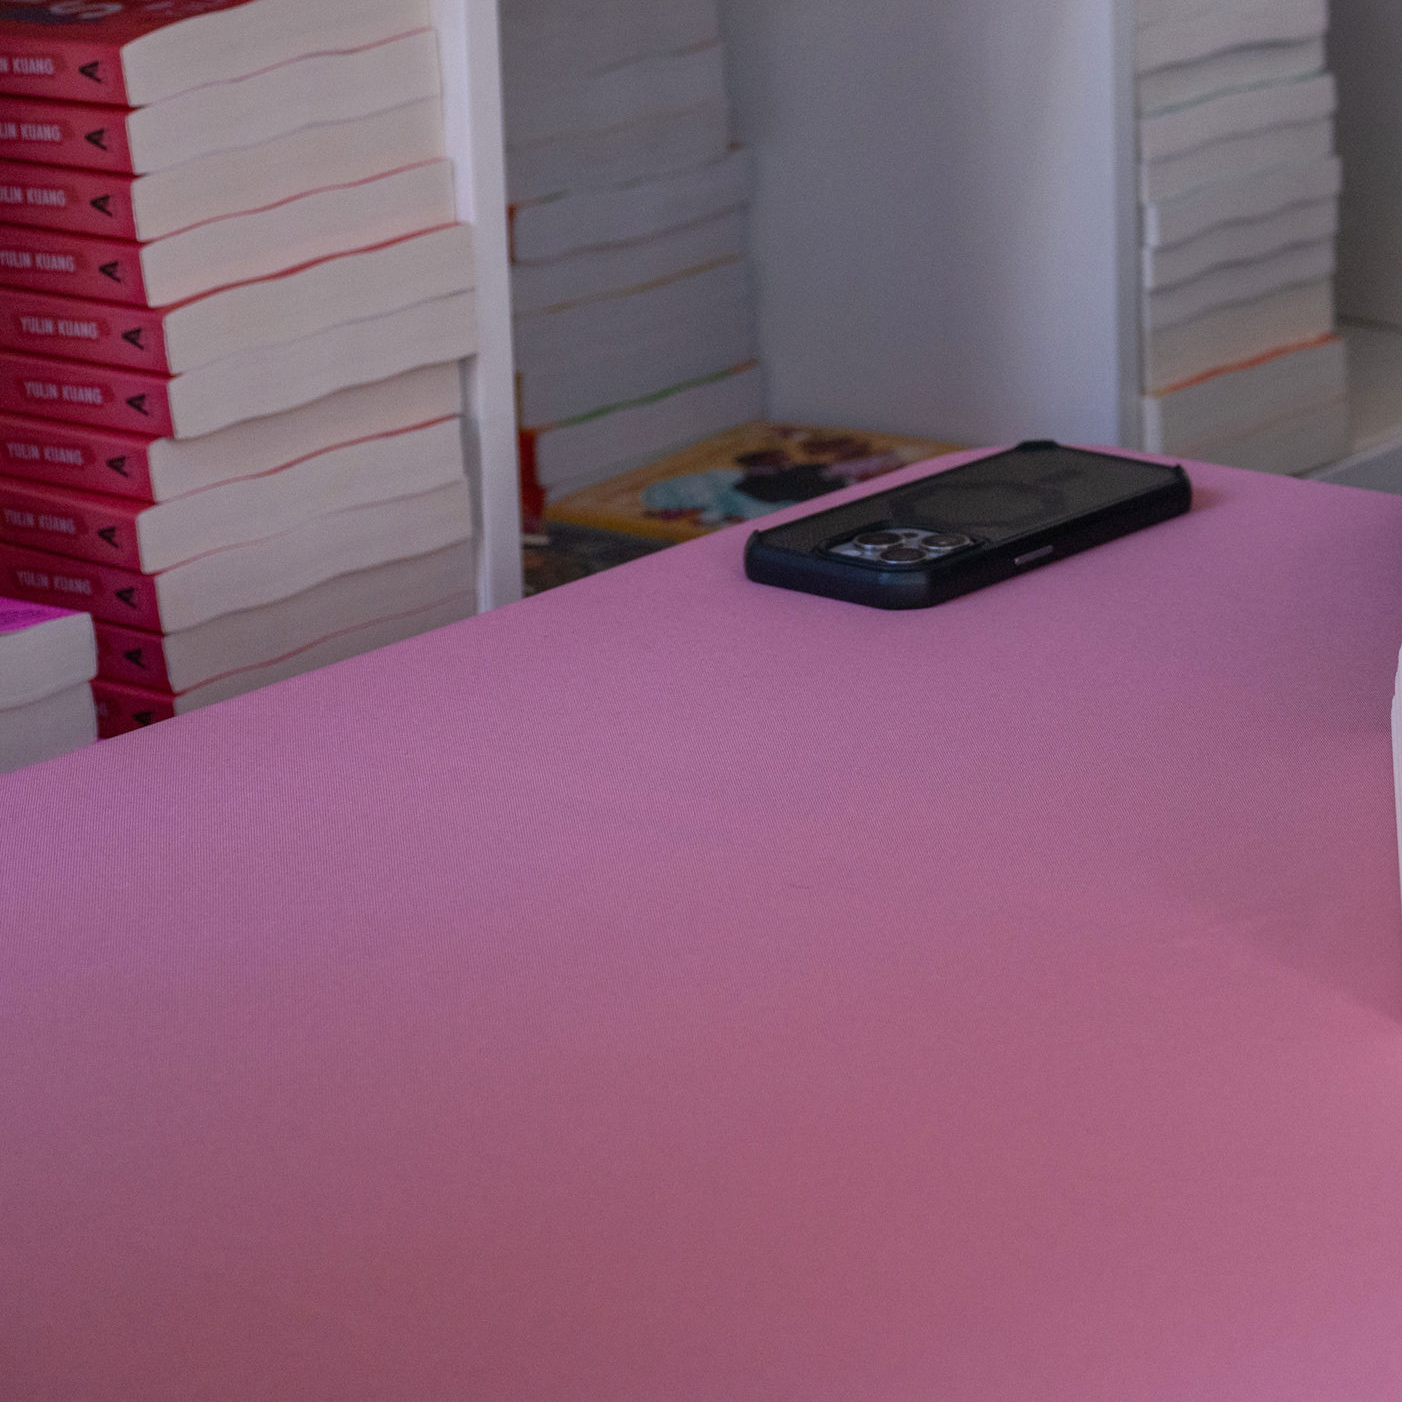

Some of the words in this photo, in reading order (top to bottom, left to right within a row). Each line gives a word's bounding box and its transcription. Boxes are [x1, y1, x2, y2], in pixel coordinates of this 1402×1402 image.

[12, 57, 54, 75] KUANG
[21, 124, 62, 142] KUANG
[27, 189, 66, 207] KUANG
[35, 254, 75, 273] KUANG
[20, 316, 54, 336] YULIN
[57, 319, 98, 340] KUANG
[24, 380, 59, 401] YULIN
[62, 383, 103, 405] KUANG
[7, 442, 41, 462] YULIN
[44, 445, 84, 467] KUANG
[3, 508, 35, 530] YULIN
[38, 512, 76, 535] KUANG
[15, 570, 49, 591] YULIN
[52, 573, 91, 597] KUANG
